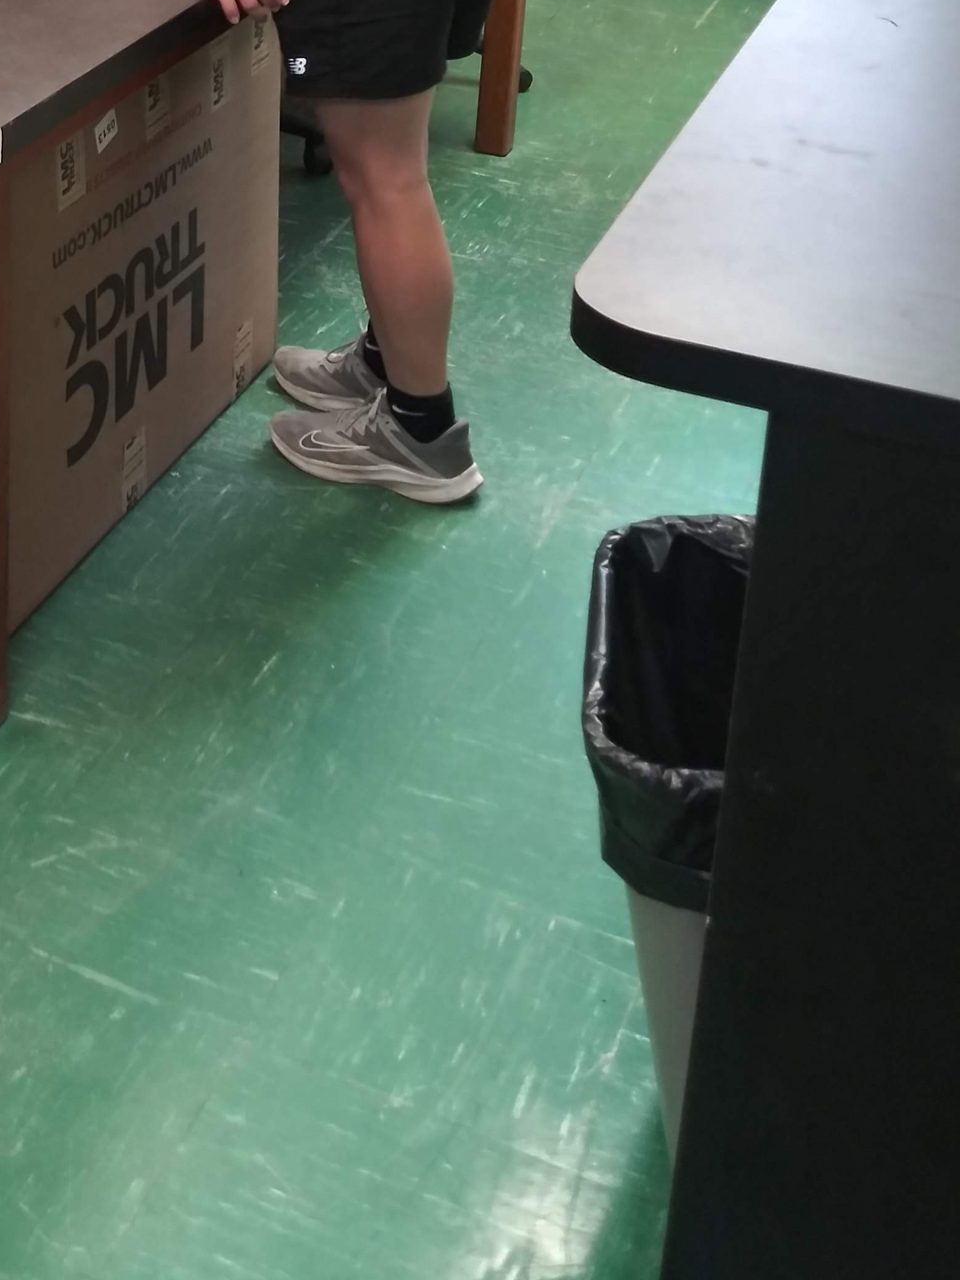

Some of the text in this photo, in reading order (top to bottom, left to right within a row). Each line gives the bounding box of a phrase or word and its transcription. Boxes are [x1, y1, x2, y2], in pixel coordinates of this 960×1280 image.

[52, 137, 213, 269] www.LMCTRUCK.com
[62, 207, 206, 370] TRUCK
[65, 262, 206, 469] LMC
